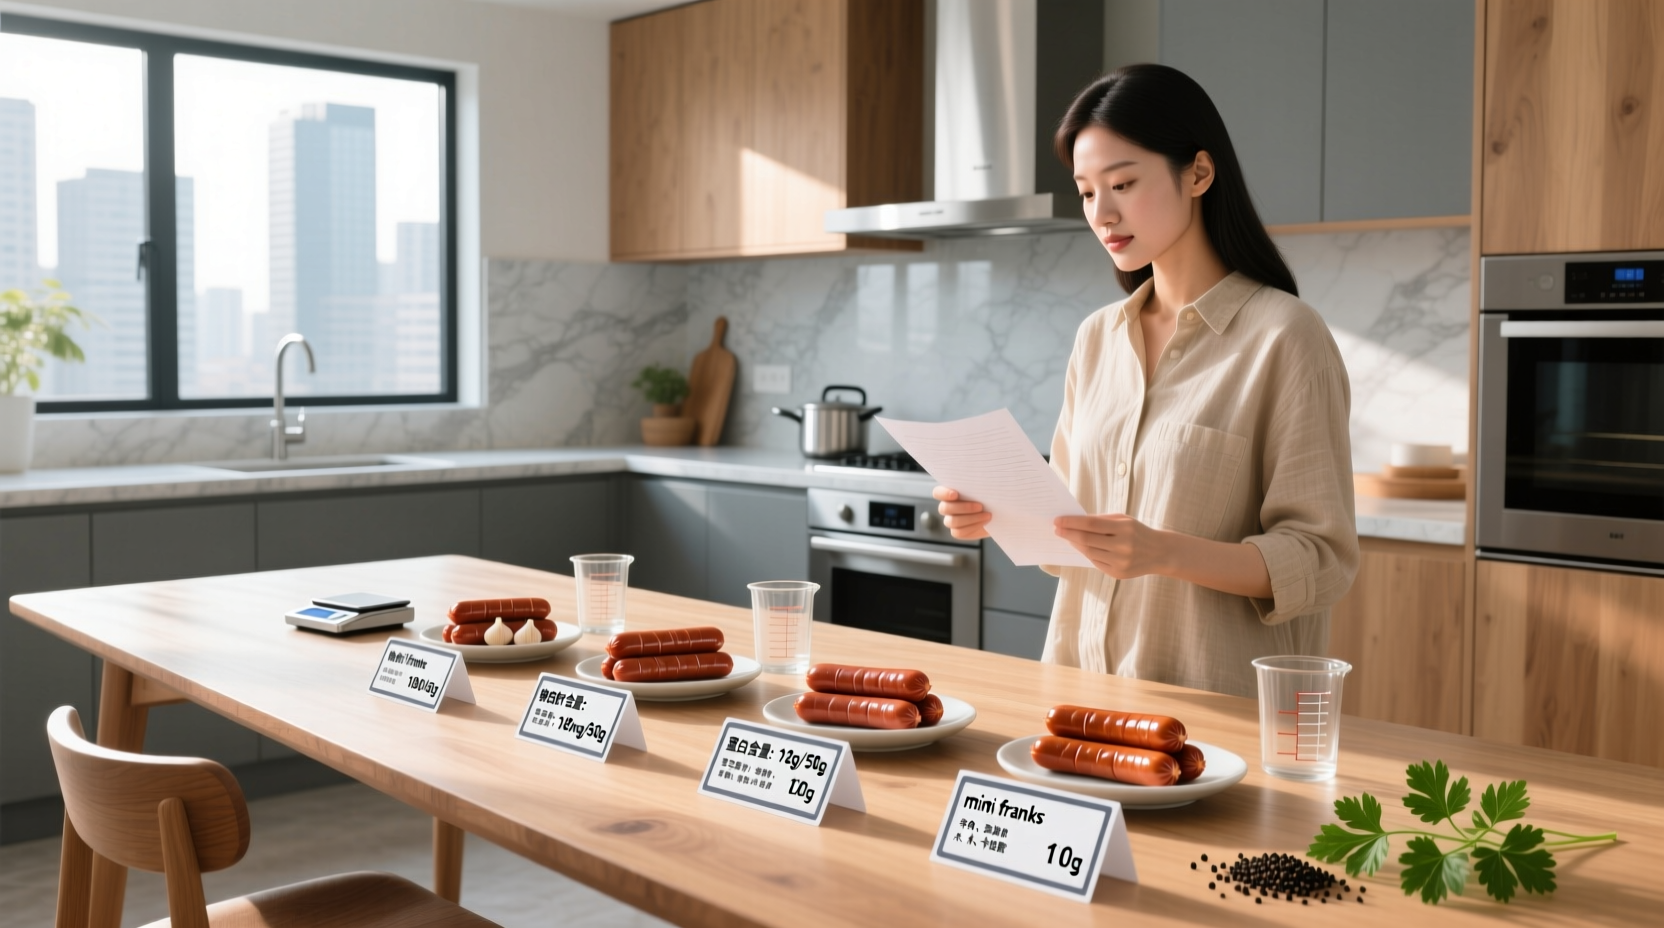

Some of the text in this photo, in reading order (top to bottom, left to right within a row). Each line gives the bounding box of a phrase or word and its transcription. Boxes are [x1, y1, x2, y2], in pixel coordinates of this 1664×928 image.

[778, 748, 828, 777] 12g/50g
[963, 794, 1045, 825] mini franks
[1046, 842, 1083, 876] 10g
